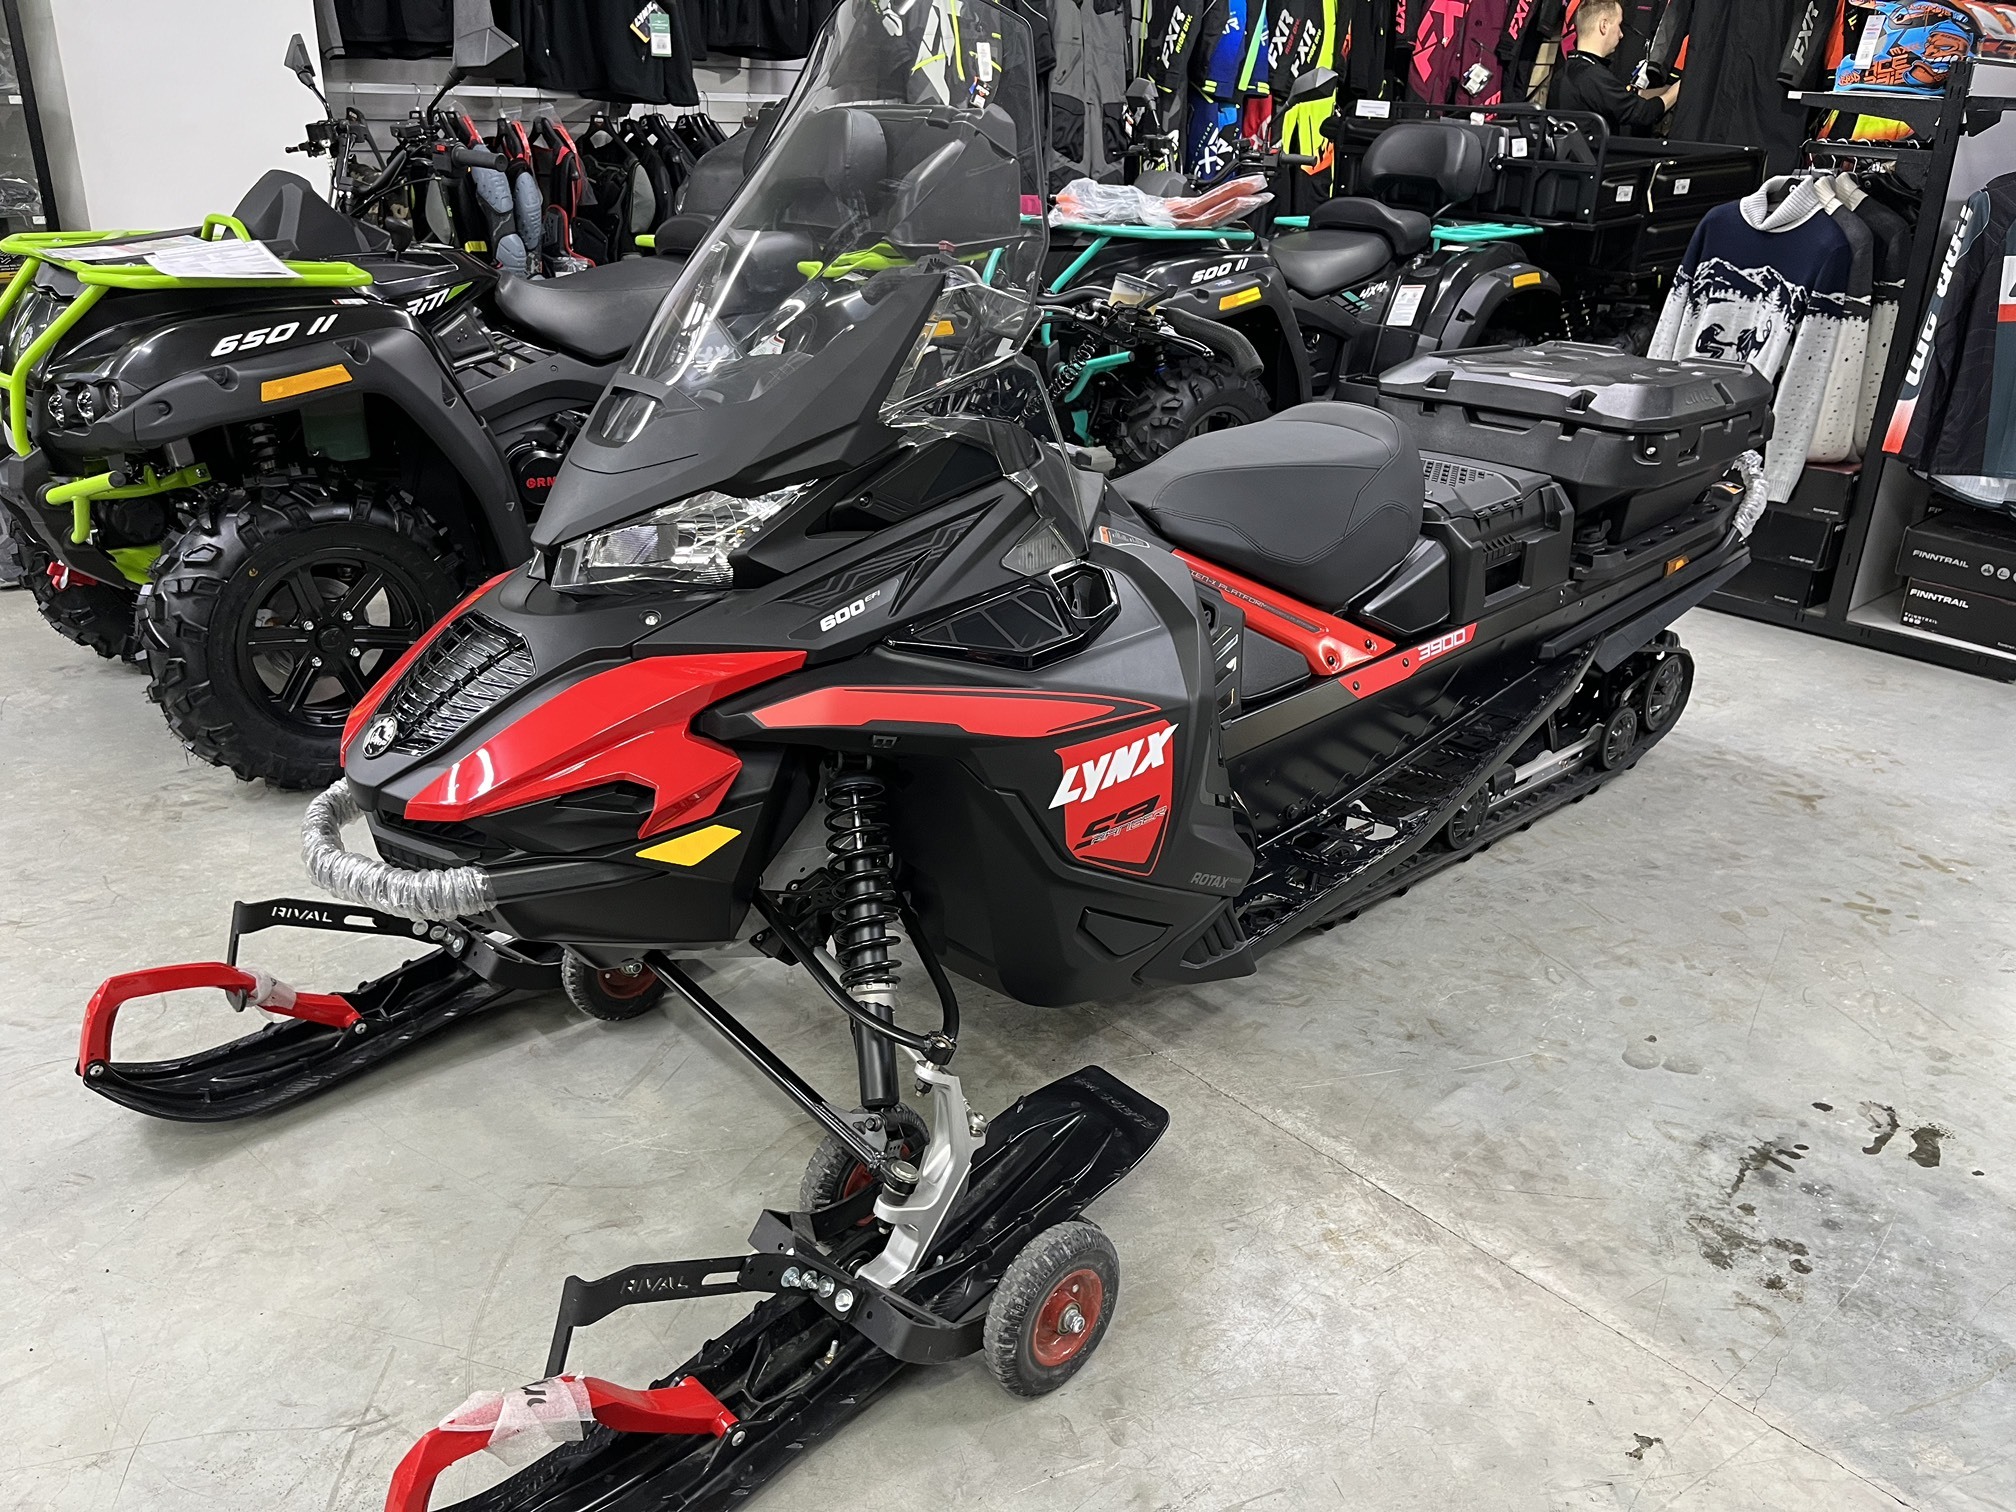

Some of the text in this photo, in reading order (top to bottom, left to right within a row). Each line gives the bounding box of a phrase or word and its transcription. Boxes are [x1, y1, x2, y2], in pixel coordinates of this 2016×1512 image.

[1161, 5, 1186, 69] FXR
[1267, 9, 1294, 70] FXR
[1291, 19, 1317, 78] FXR
[1190, 262, 1232, 285] 500
[1235, 257, 1249, 270] II
[210, 313, 339, 358] 650 II
[1912, 549, 1969, 568] FINNTRAIL
[1218, 582, 1267, 609] PLATFORM
[1909, 588, 1969, 609] FINNTRAIL
[820, 599, 866, 632] 600
[1417, 627, 1467, 661] 3900
[1048, 723, 1180, 810] LYNX
[1190, 872, 1230, 889] ROTAX
[271, 906, 333, 922] RIVAL
[620, 1275, 690, 1295] RIVAL
